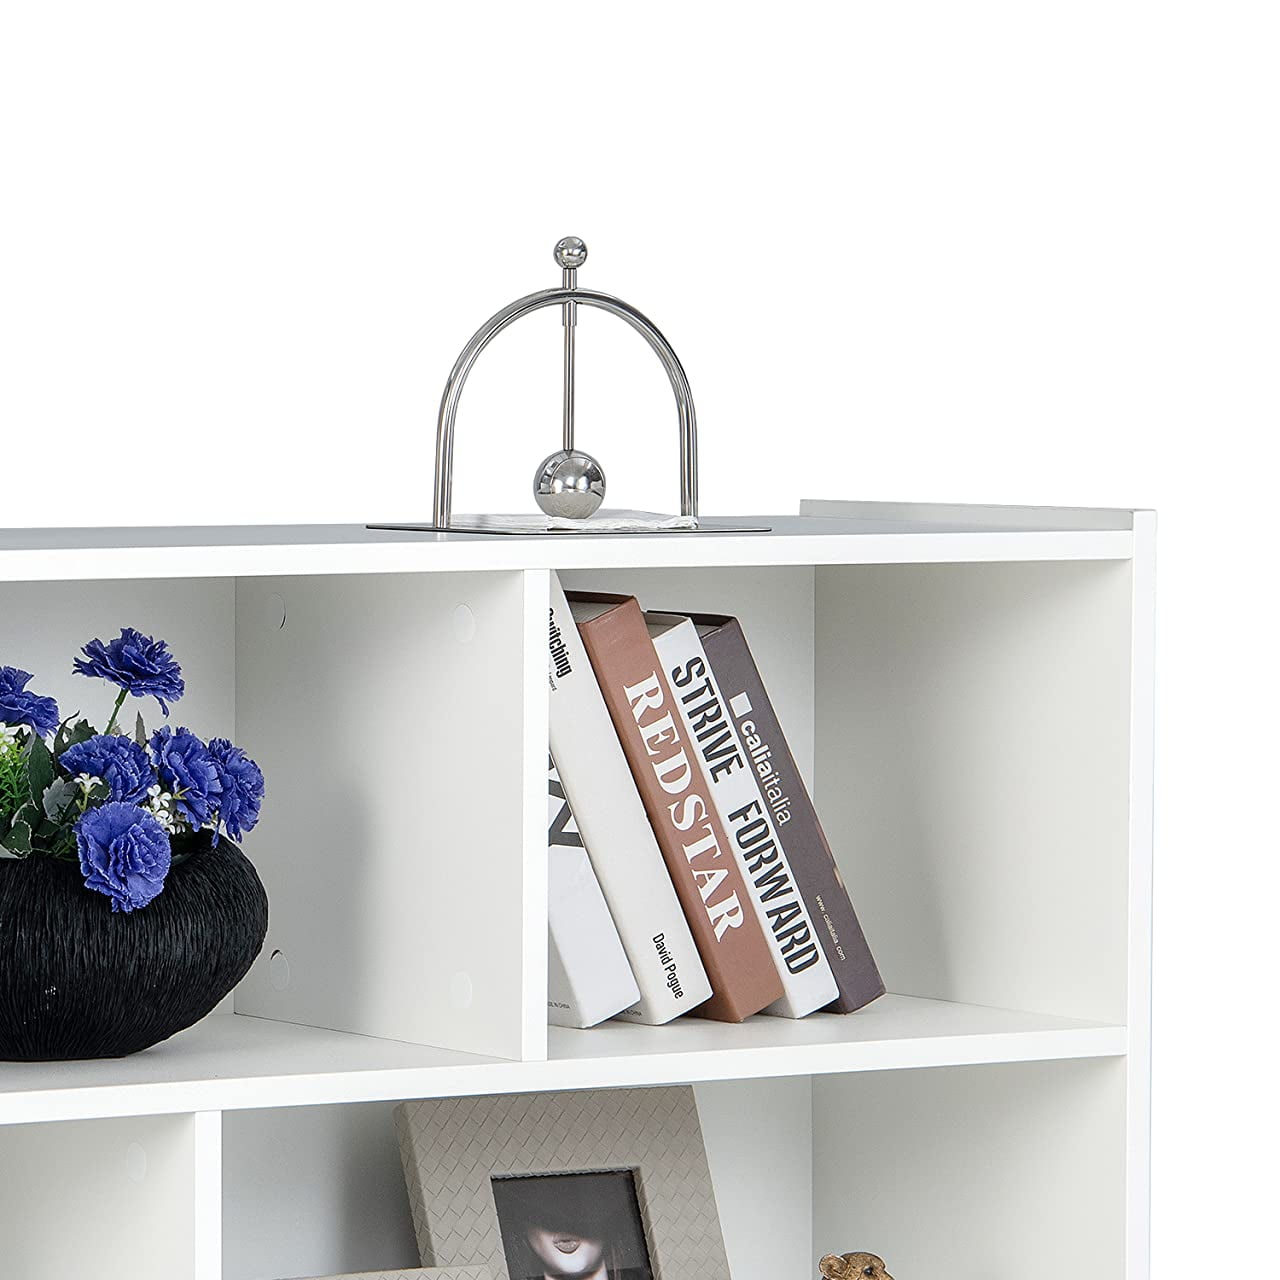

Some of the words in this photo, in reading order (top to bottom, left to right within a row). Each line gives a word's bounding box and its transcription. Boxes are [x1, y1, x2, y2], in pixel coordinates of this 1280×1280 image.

[671, 656, 744, 784] STRIVE
[728, 799, 819, 975] FORWARD
[740, 719, 792, 827] caliaitalia
[652, 932, 673, 965] David
[664, 964, 684, 999] Pogue
